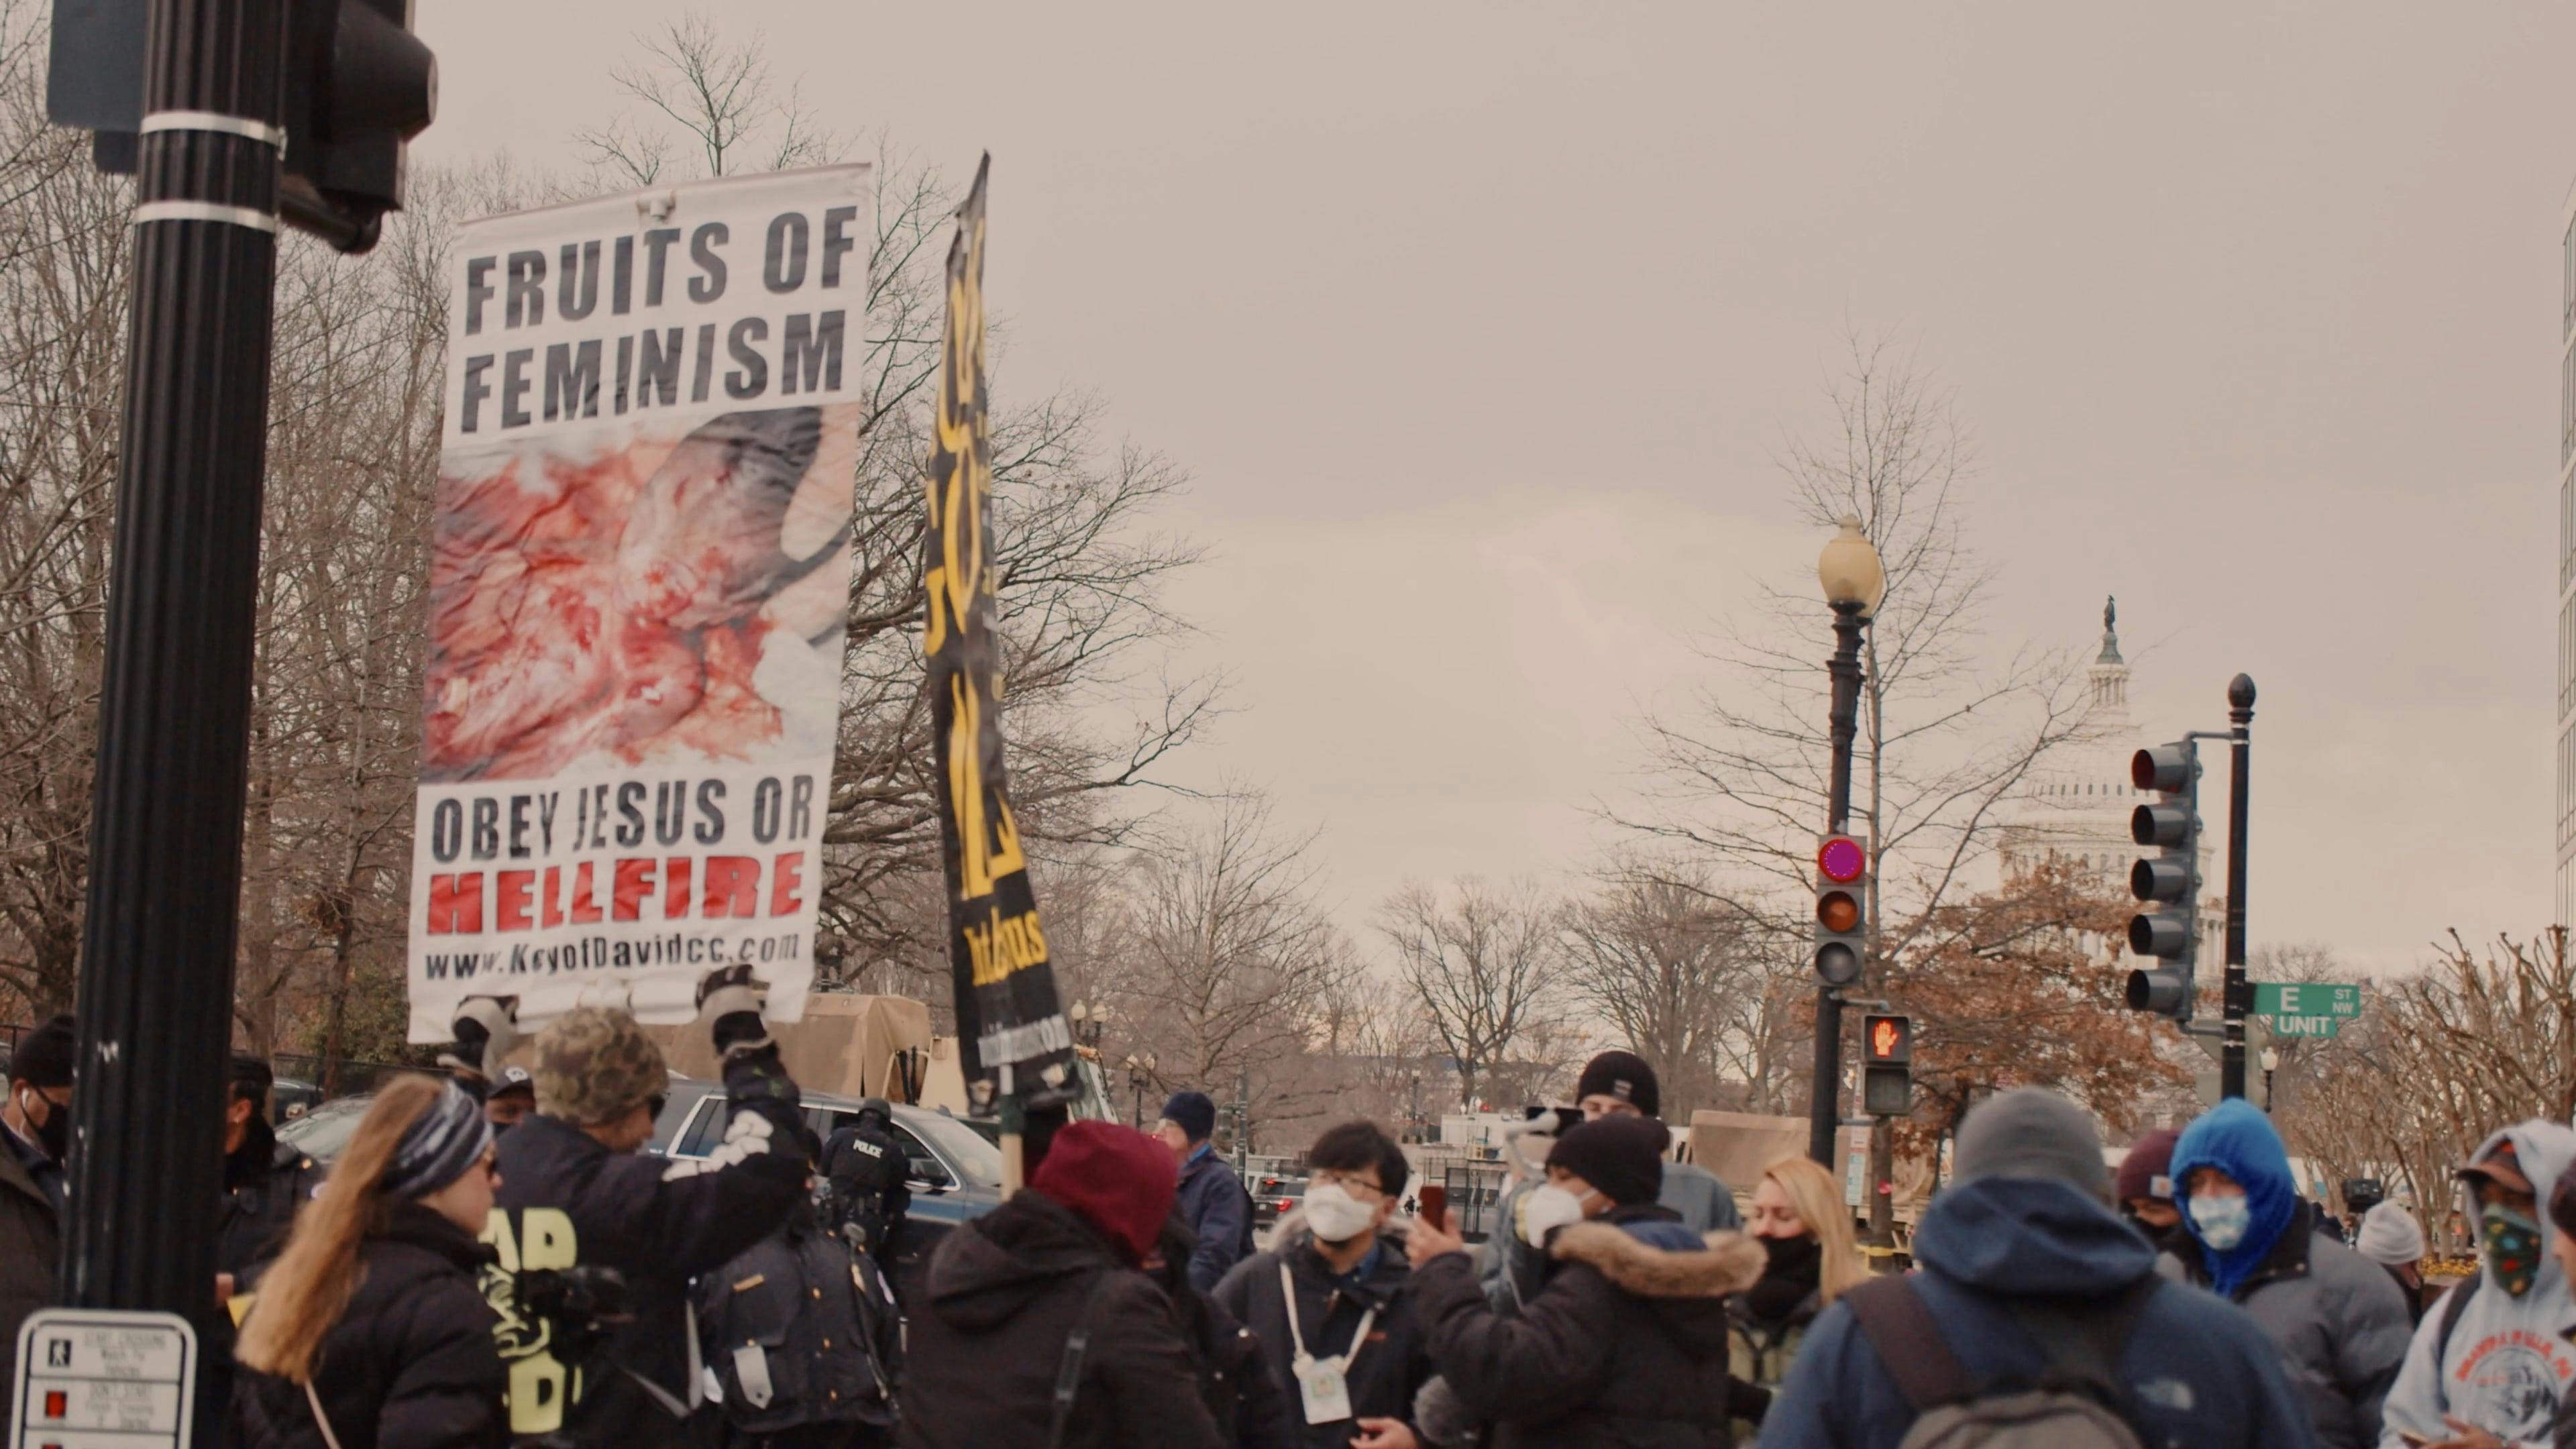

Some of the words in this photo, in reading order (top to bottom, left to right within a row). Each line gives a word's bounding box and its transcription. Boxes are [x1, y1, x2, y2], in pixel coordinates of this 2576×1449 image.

[466, 222, 729, 335] FRUITS
[763, 206, 857, 294] OF
[461, 310, 846, 433] FEMINISM
[432, 791, 559, 863] OBEY
[572, 778, 727, 851] JESUS
[753, 775, 814, 844] OR
[427, 851, 804, 935] HELLFIRE
[2279, 1016, 2330, 1034] UNIT
[2281, 987, 2300, 1012] E
[2335, 989, 2352, 1000] ST
[2333, 1002, 2353, 1014] NW
[853, 1138, 883, 1159] POLICE
